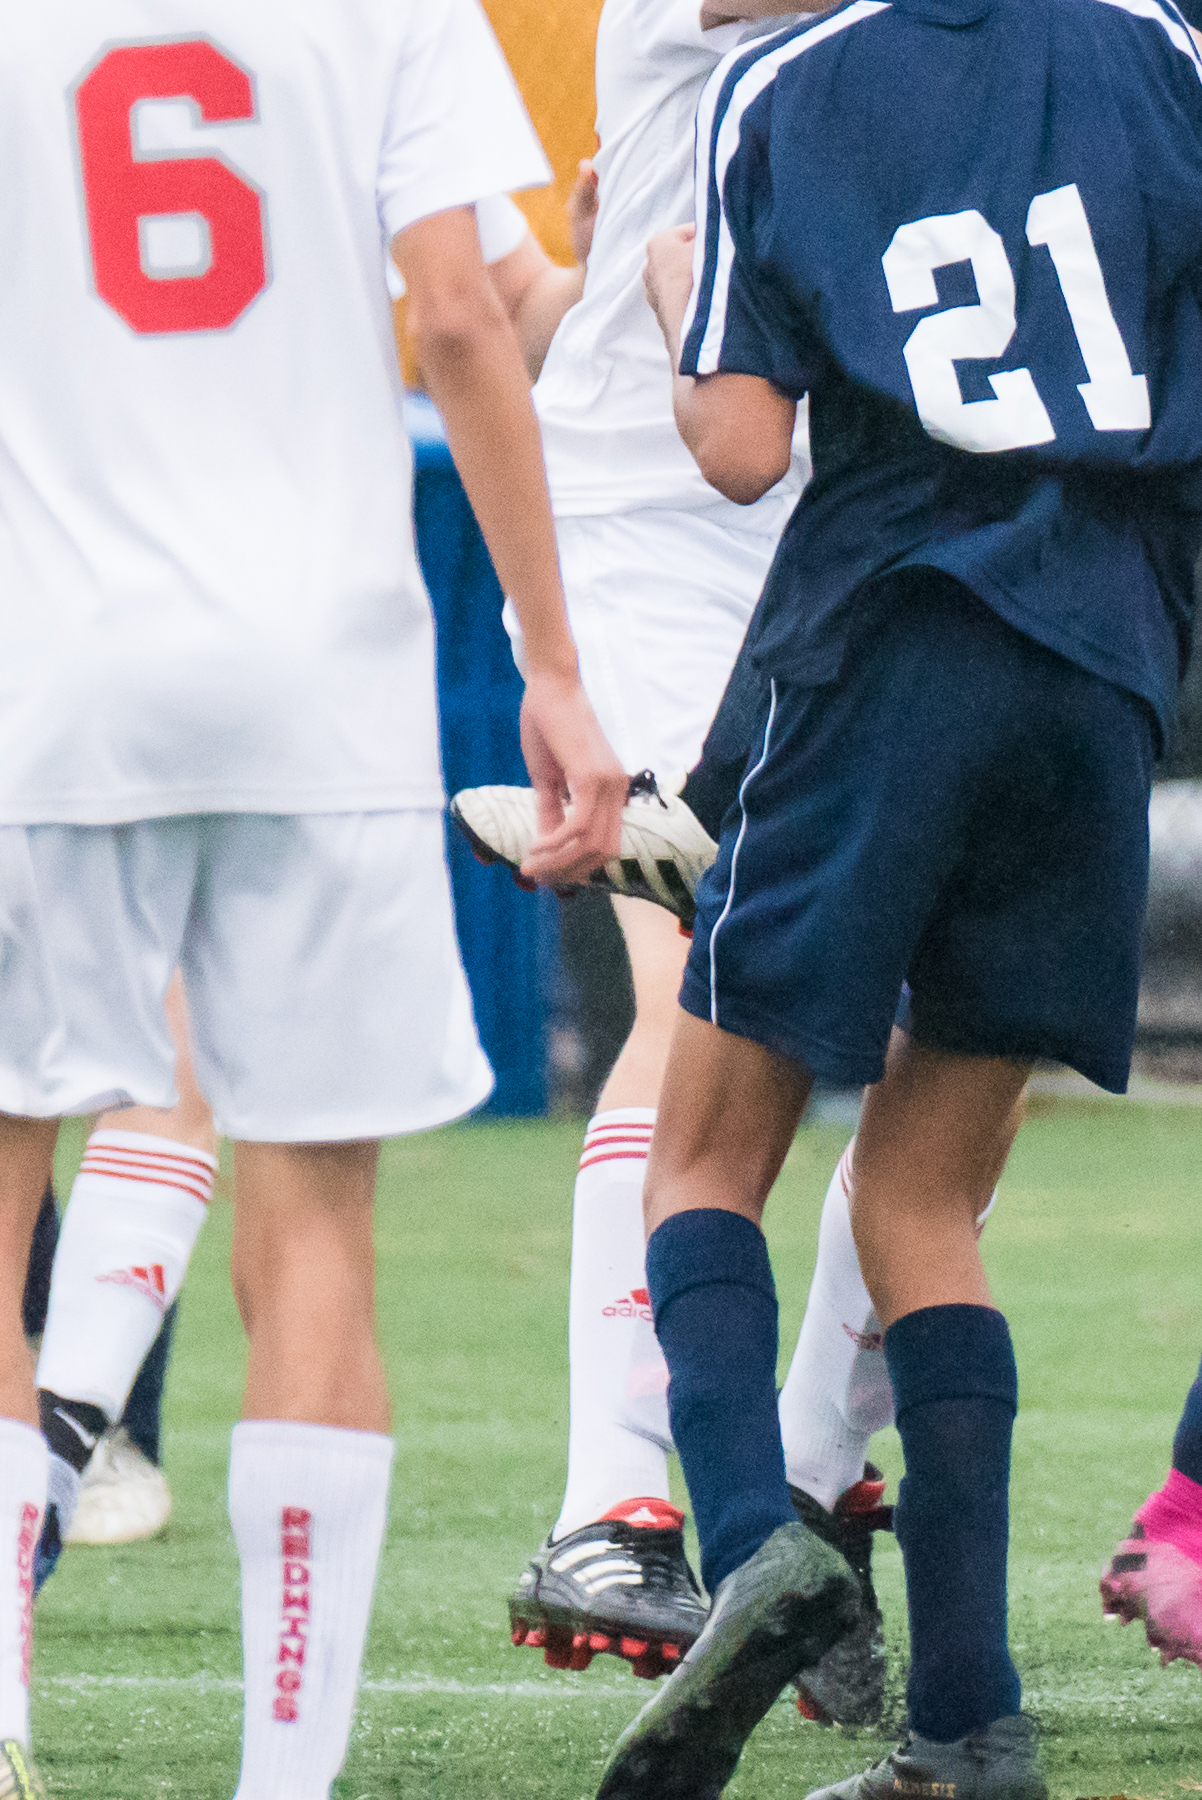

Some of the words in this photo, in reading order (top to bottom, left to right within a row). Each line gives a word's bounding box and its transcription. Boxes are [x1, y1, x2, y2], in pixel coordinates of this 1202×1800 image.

[65, 31, 274, 340] 6
[881, 182, 1151, 454] 21
[272, 1505, 312, 1723] REDWINGS
